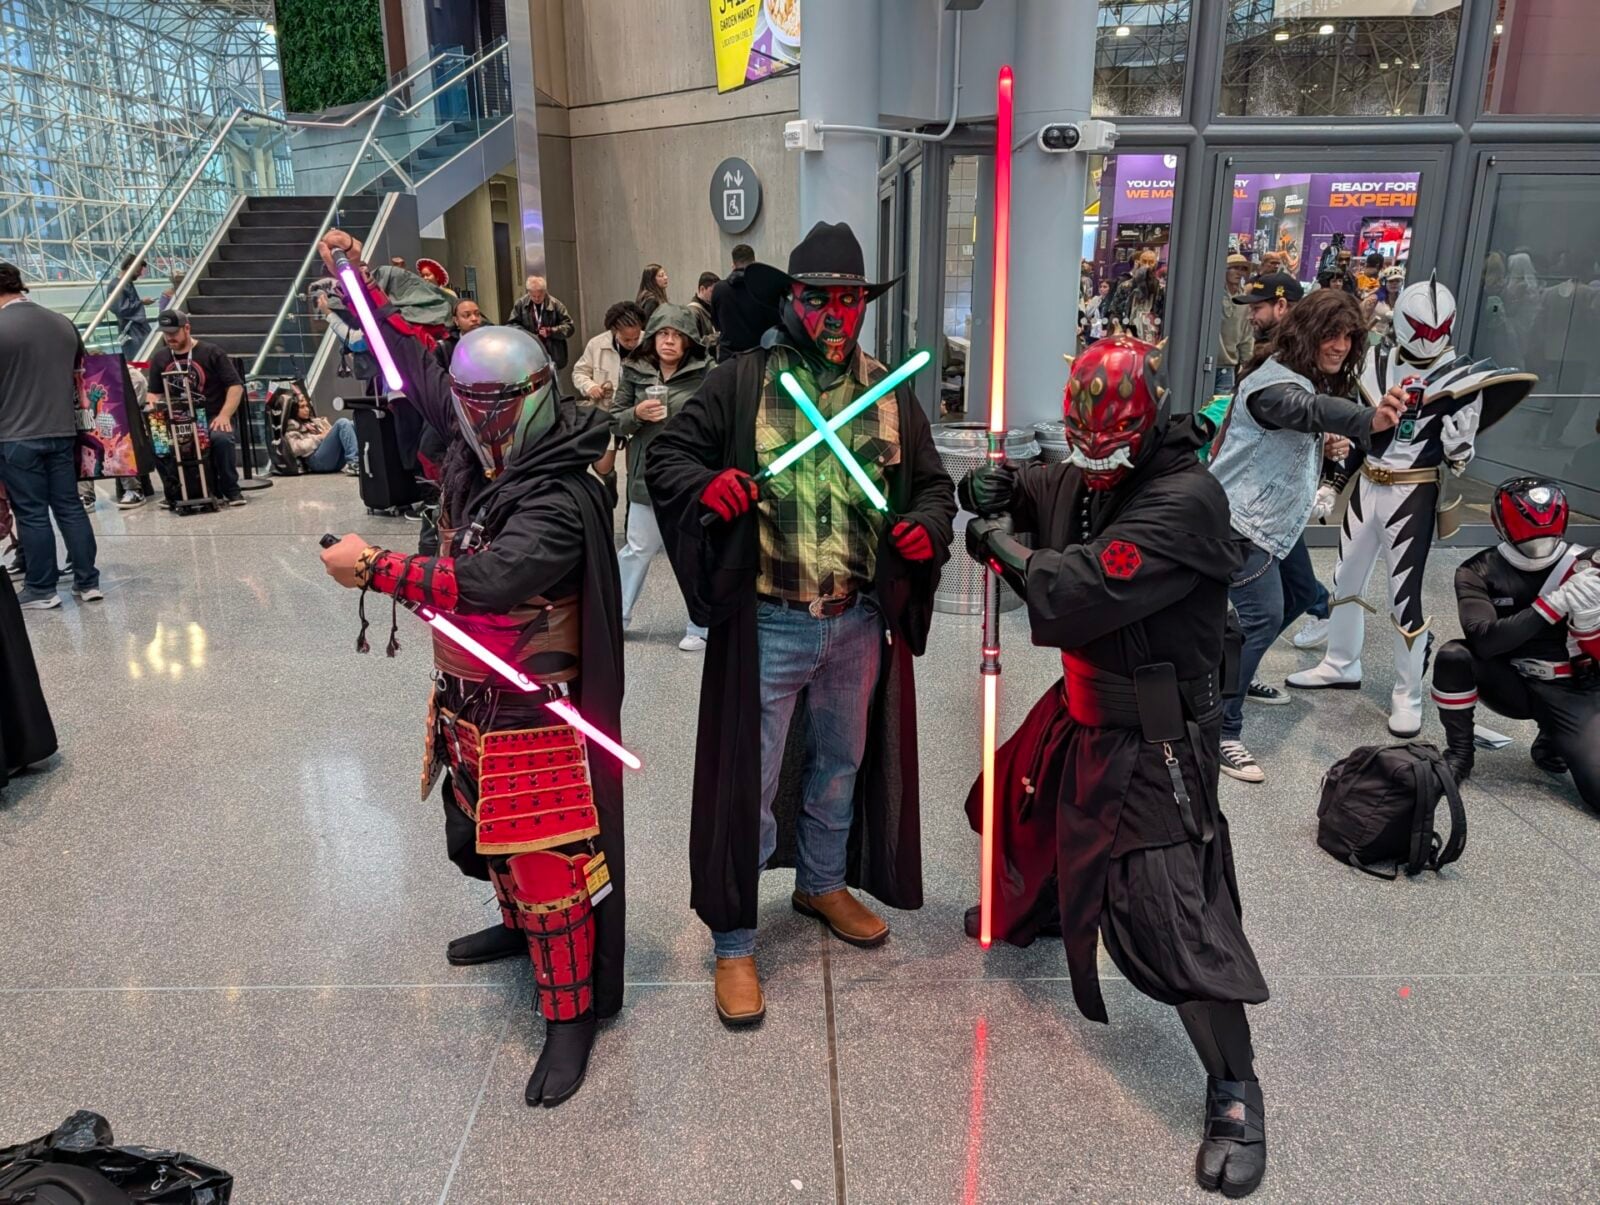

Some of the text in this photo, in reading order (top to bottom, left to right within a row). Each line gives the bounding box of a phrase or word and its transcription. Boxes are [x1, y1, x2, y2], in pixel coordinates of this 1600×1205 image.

[1127, 180, 1152, 188] YOU
[1332, 182, 1417, 192] READY FOR
[1126, 189, 1149, 198] WE
